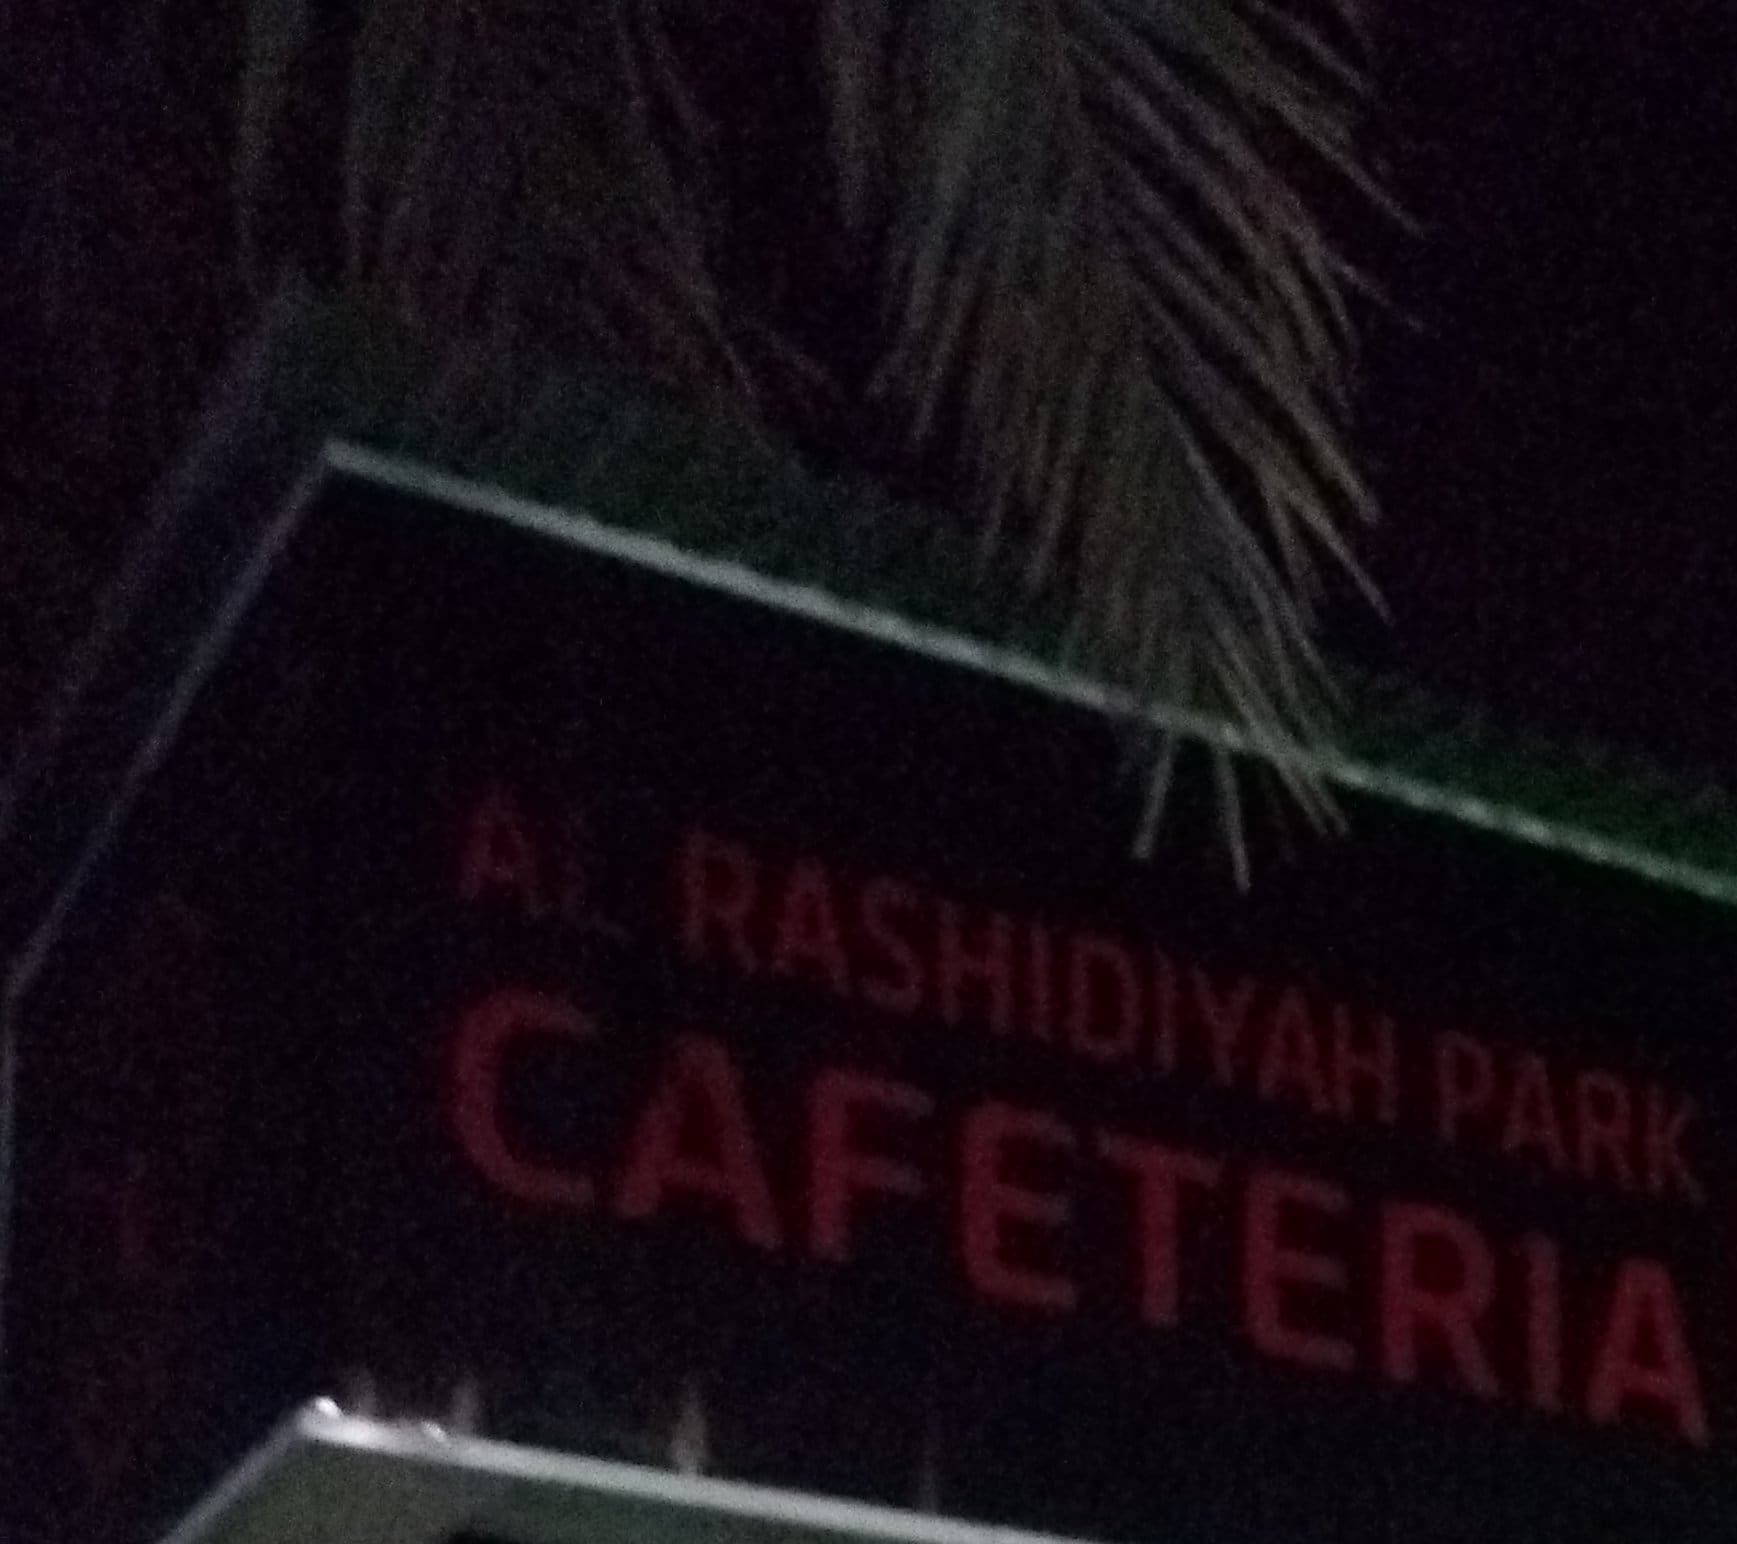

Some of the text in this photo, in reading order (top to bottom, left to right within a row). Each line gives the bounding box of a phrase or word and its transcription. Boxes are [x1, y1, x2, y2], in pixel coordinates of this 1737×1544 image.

[446, 982, 1712, 1450] CAFETERIA
[678, 829, 1398, 1127] RASHIDIYAH
[1432, 1026, 1708, 1200] PARK
